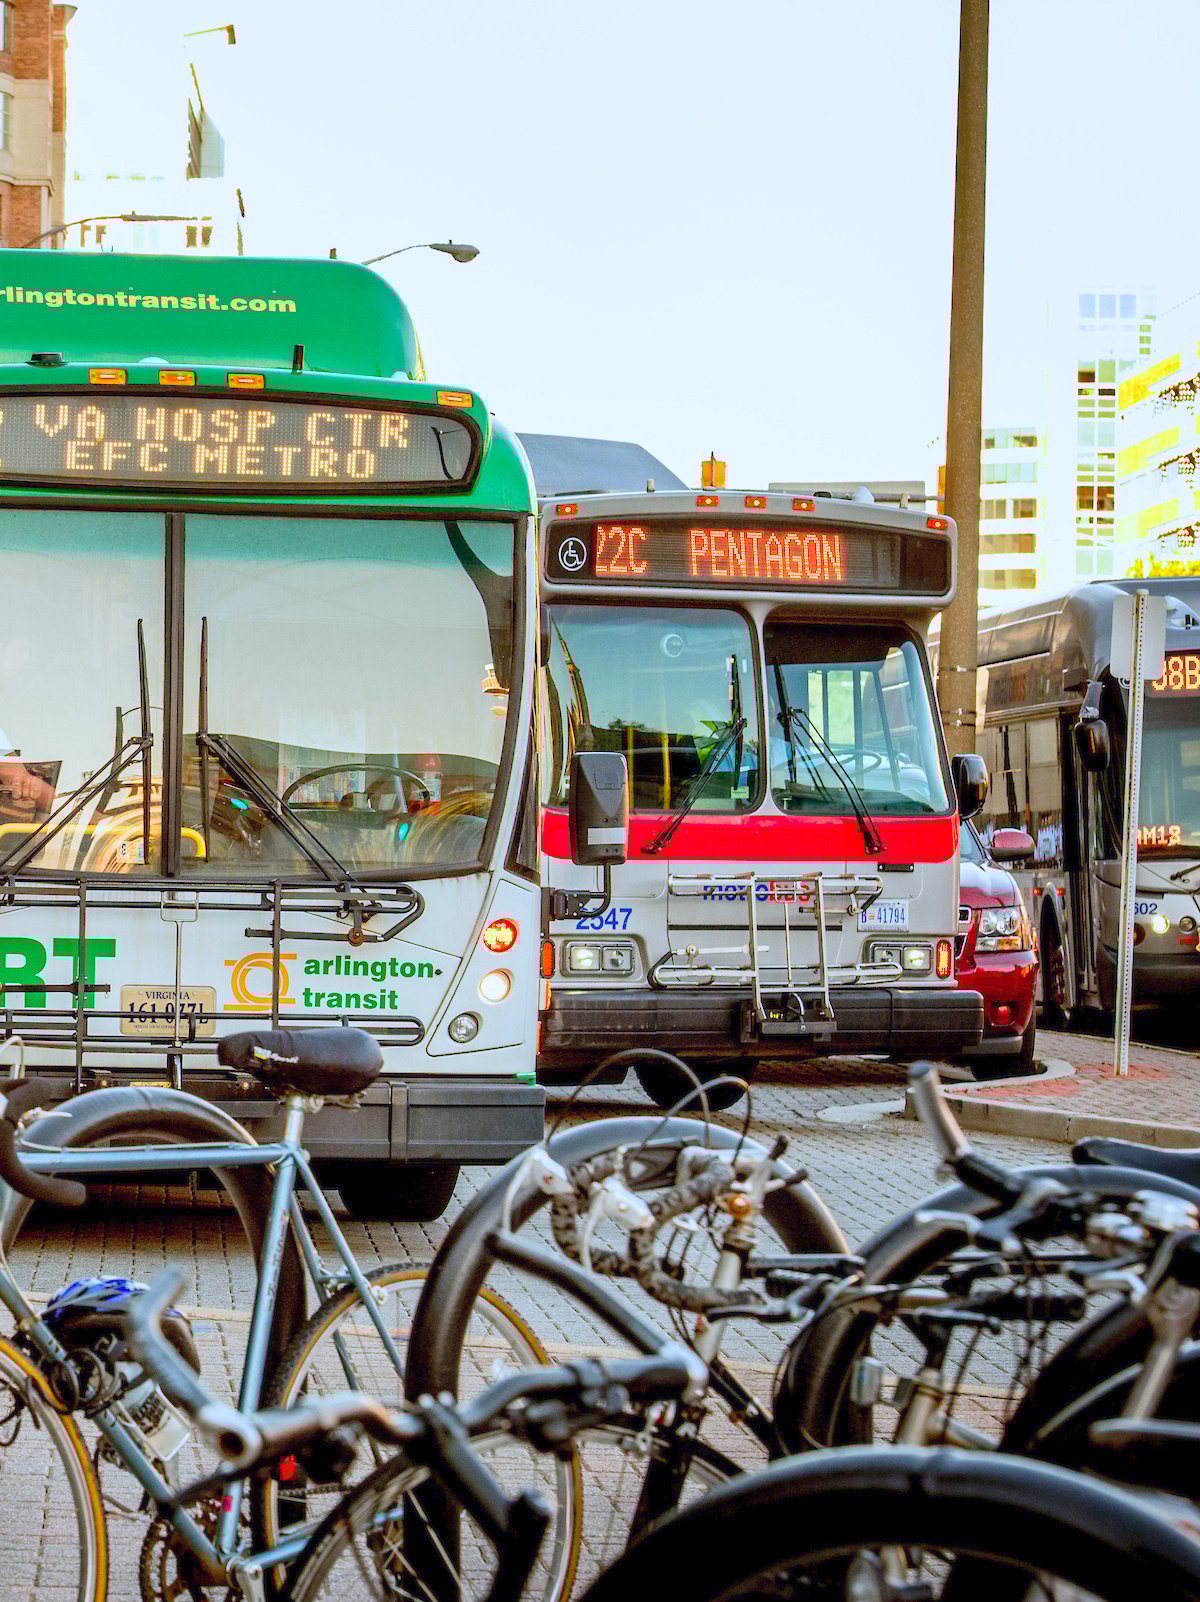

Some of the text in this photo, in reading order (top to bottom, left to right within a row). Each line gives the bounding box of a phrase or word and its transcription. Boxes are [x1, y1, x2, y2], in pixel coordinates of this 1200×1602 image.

[35, 403, 409, 449] VA HOSP CTR
[65, 440, 376, 479] EFC METRO
[689, 529, 843, 580] PENTAGON
[575, 907, 633, 931] 2547
[877, 907, 905, 924] 41794
[303, 955, 434, 982] arlington
[145, 991, 191, 1000] VIRGINIA
[302, 987, 399, 1010] transit
[128, 1002, 158, 1024] 161
